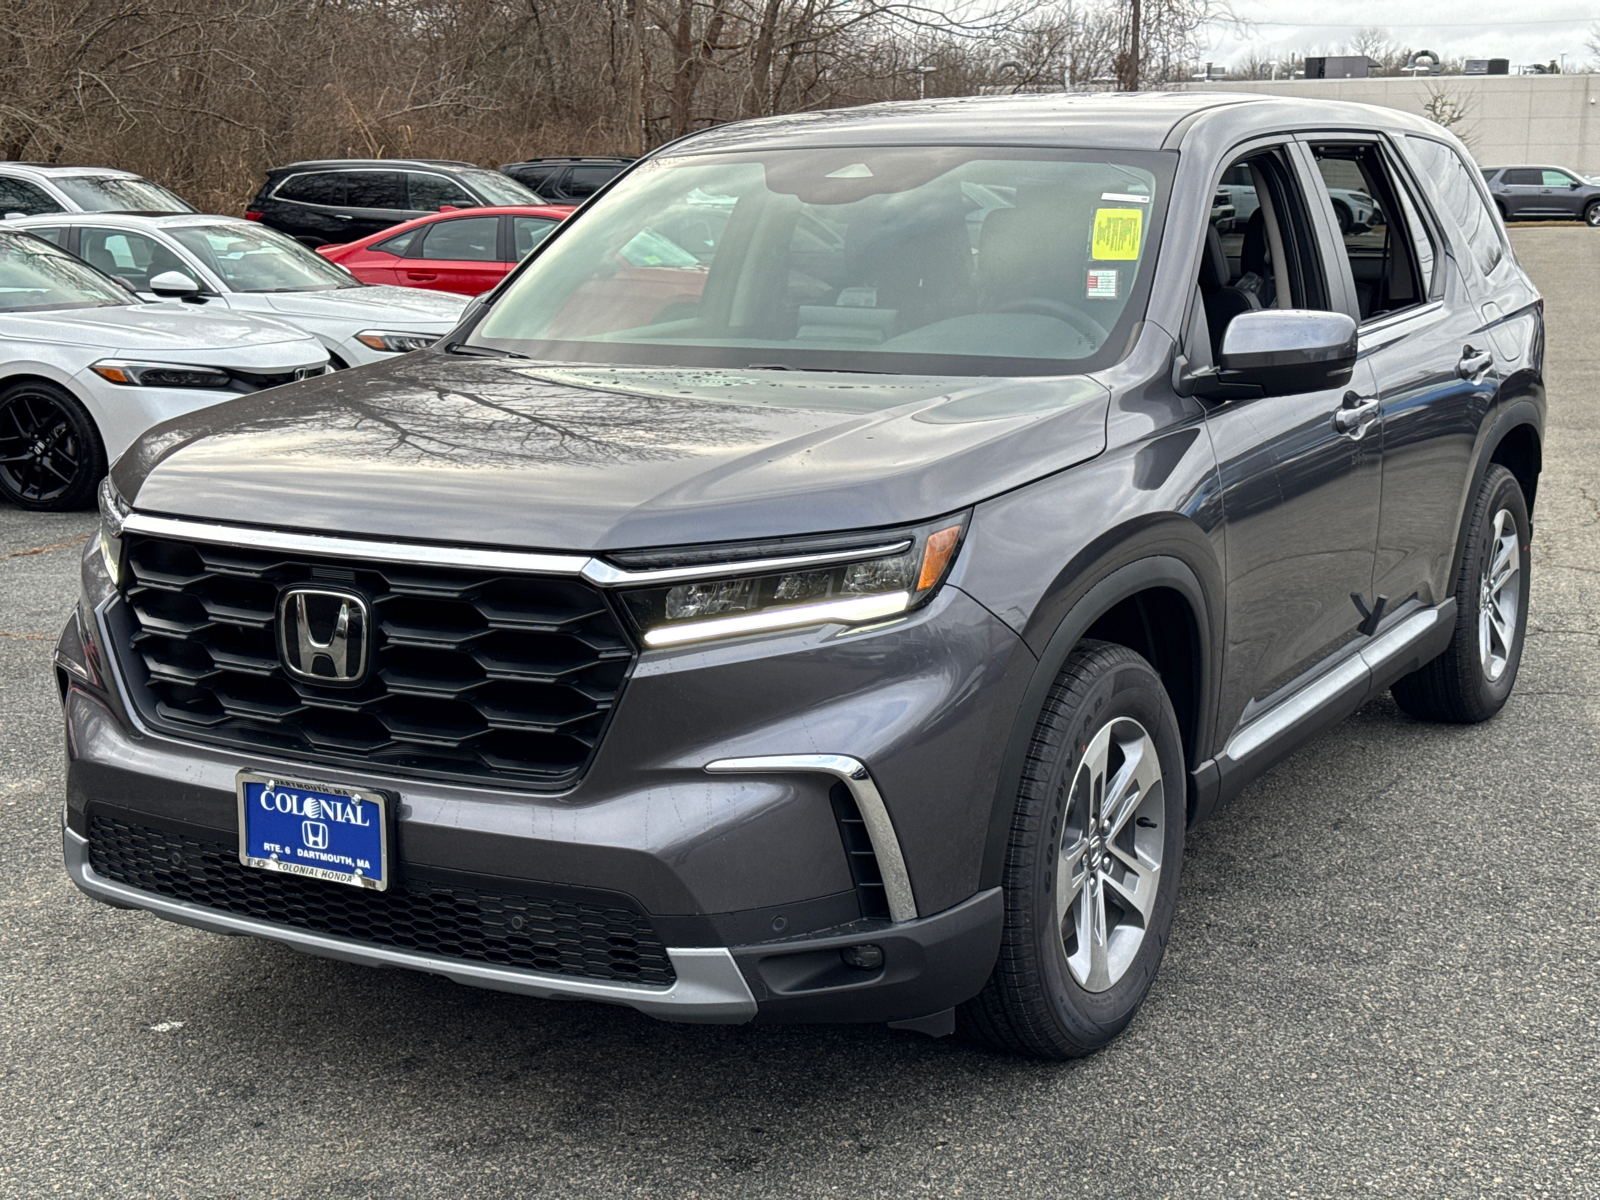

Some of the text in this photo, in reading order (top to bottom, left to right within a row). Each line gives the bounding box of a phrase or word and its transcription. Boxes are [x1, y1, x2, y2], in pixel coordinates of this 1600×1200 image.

[335, 788, 349, 796] MA
[1045, 696, 1102, 894] GOODYEAR
[260, 790, 369, 827] COLONIAL
[263, 842, 371, 869] RTE. 6 DARTMOUTH, MA
[277, 862, 353, 883] COLONIAL HONDA
